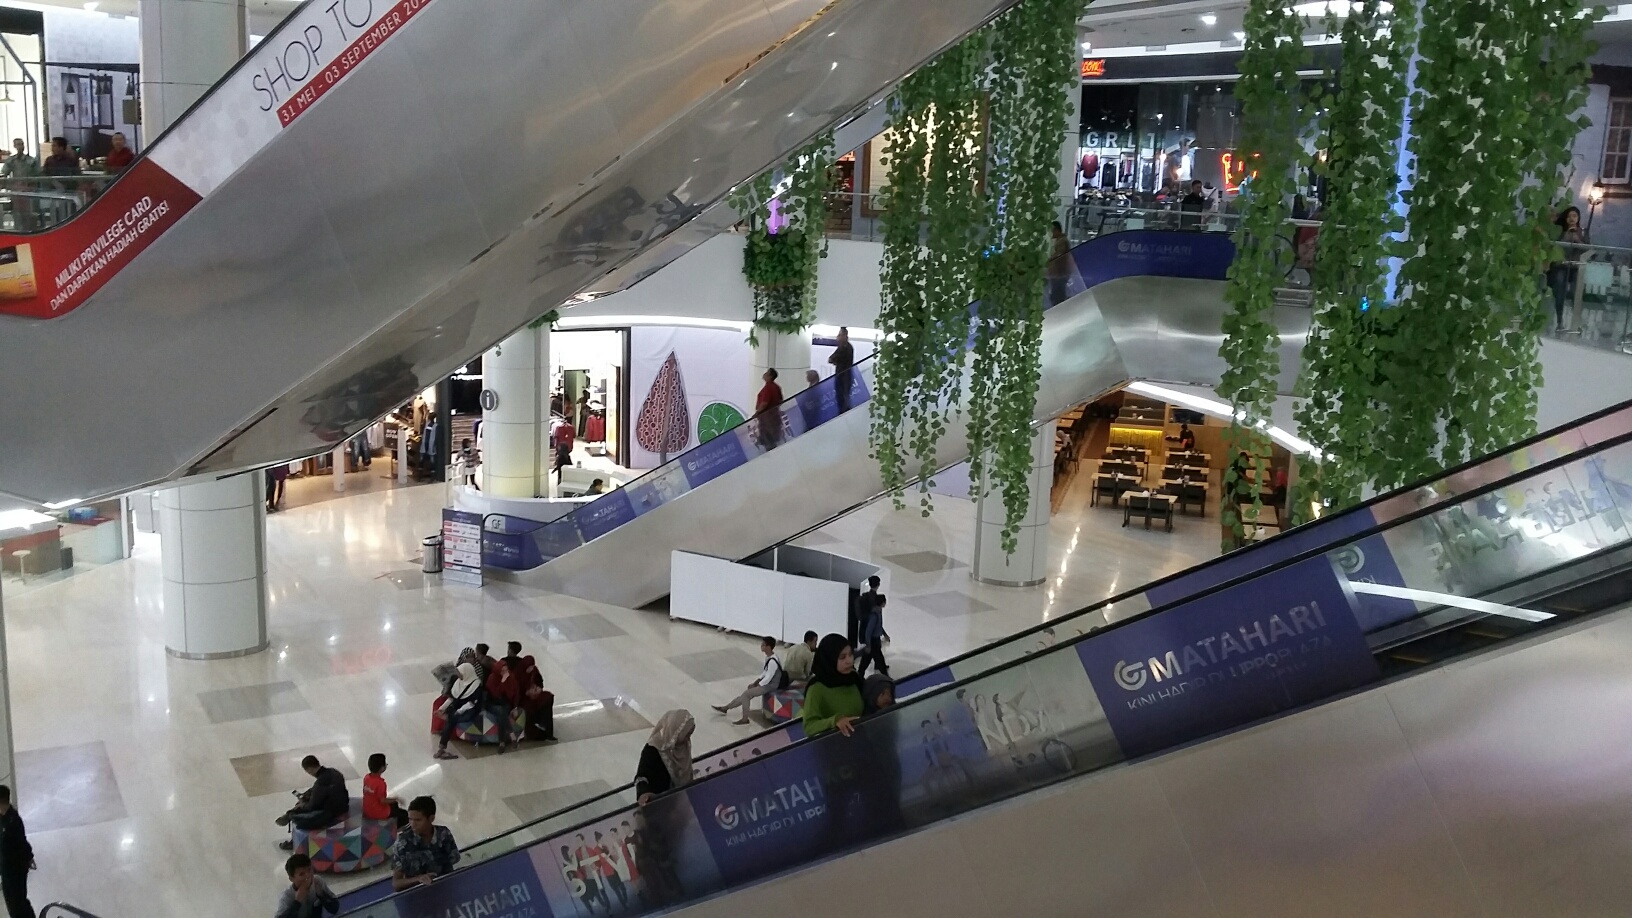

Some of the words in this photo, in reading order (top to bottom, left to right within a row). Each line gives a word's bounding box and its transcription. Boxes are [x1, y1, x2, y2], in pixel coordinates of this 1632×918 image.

[252, 25, 323, 111] SHOP
[281, 105, 296, 122] 31
[296, 86, 317, 109] MEI
[325, 65, 340, 84] 03
[341, 12, 402, 70] SEPTEMBER
[50, 289, 68, 311] DAN
[67, 255, 108, 296] DAPATKAN
[106, 229, 138, 262] HADIAH
[137, 199, 170, 233] GRATIS!
[55, 258, 82, 289] MILIKI
[80, 220, 126, 266] PRIVILEGE
[124, 195, 152, 226] CARD
[1130, 243, 1192, 255] MATAHARI
[1148, 600, 1327, 683] MATAHARI
[1127, 692, 1157, 710] KINI
[739, 776, 825, 823] MATAH
